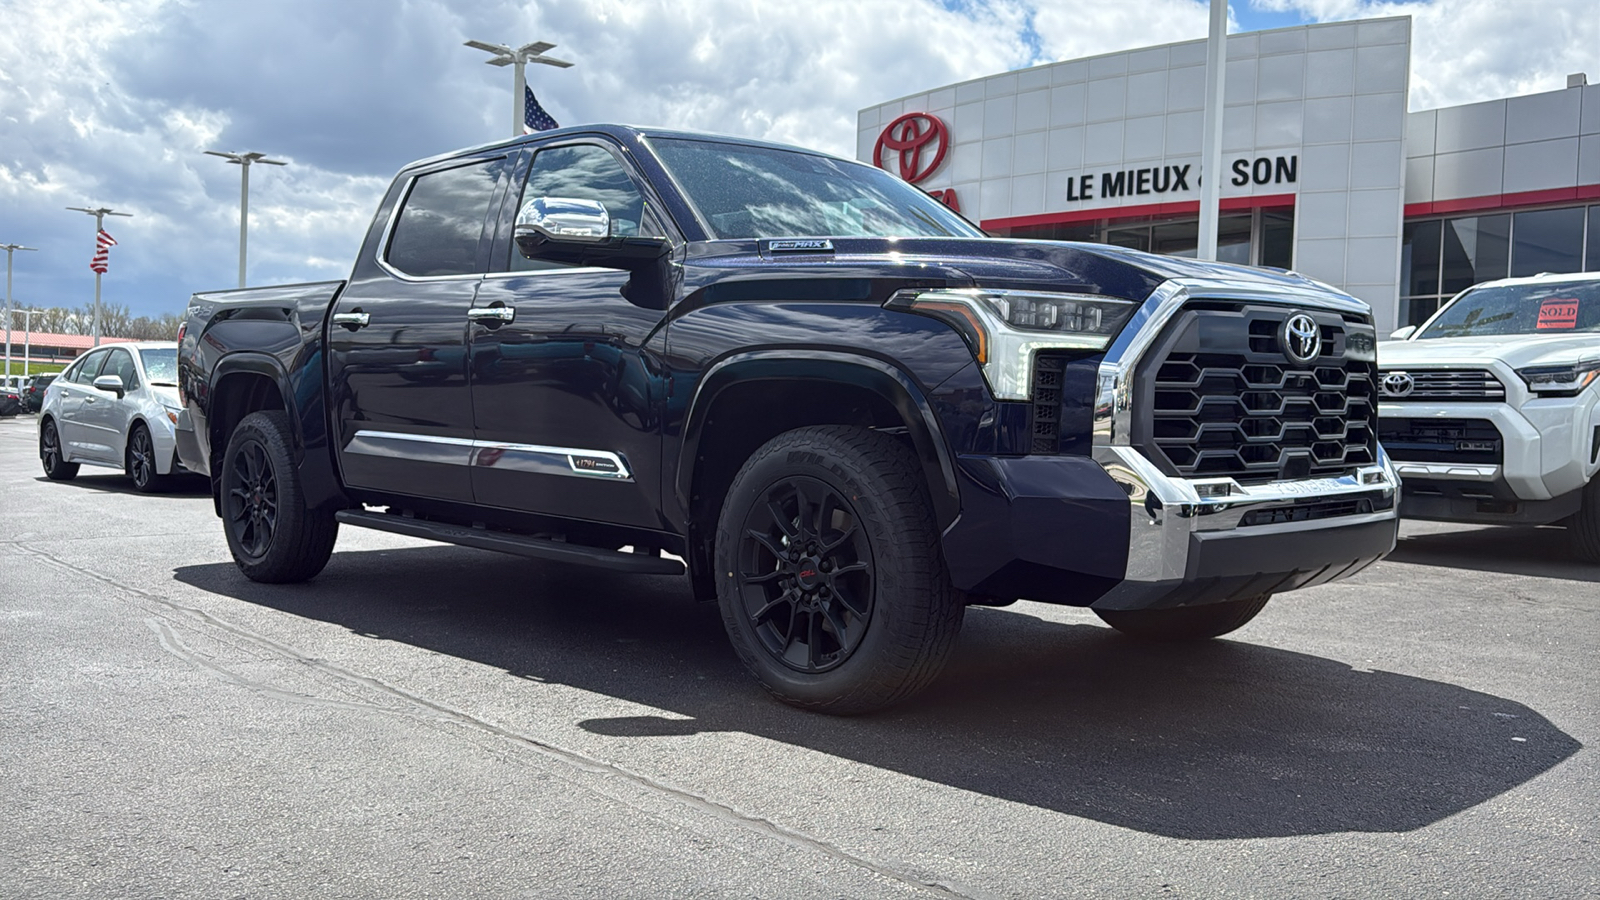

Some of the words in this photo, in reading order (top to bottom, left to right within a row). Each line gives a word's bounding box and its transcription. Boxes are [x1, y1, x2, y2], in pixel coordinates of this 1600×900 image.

[1066, 174, 1094, 202] LE
[1101, 164, 1191, 199] MIEUX
[1231, 155, 1298, 187] SON
[1540, 307, 1576, 317] SOLD
